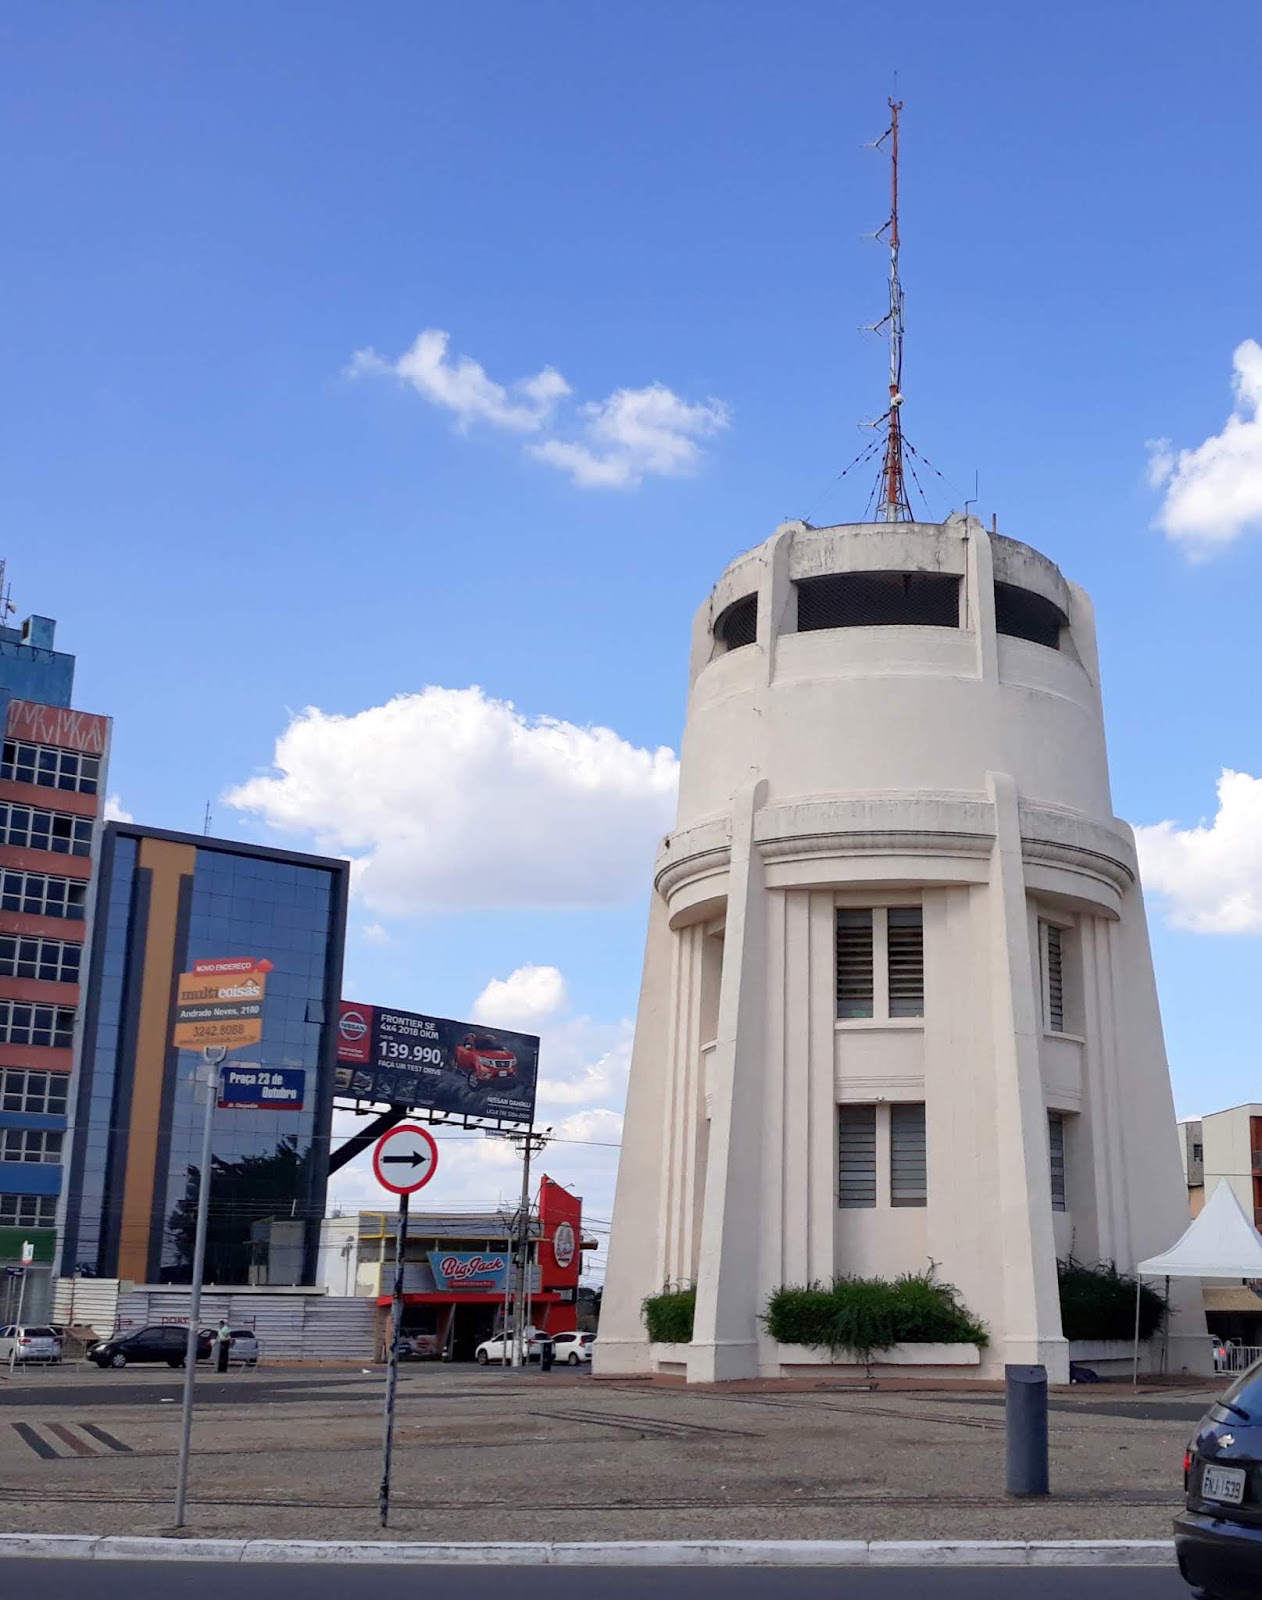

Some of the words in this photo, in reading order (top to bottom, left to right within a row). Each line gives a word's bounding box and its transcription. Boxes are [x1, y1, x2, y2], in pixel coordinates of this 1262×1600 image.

[196, 963, 215, 972] NOVO
[215, 962, 252, 971] ENDEREÇO
[180, 1008, 212, 1018] Andrade
[213, 1007, 239, 1016] Neves,
[240, 1005, 260, 1014] 2180
[340, 1021, 366, 1032] NISSAN
[380, 1022, 398, 1032] 4x4
[398, 1025, 419, 1036] 2018
[381, 1013, 423, 1030] FRONTIER
[424, 1021, 437, 1031] SE
[377, 1060, 395, 1069] FAÇA
[407, 1064, 422, 1073] TEST
[423, 1067, 442, 1076] DRIVE
[229, 1072, 256, 1086] Praça
[257, 1072, 270, 1085] 23
[271, 1073, 283, 1085] de
[262, 1086, 297, 1099] Outubro
[441, 1256, 468, 1279] Big
[468, 1256, 504, 1276] Jack
